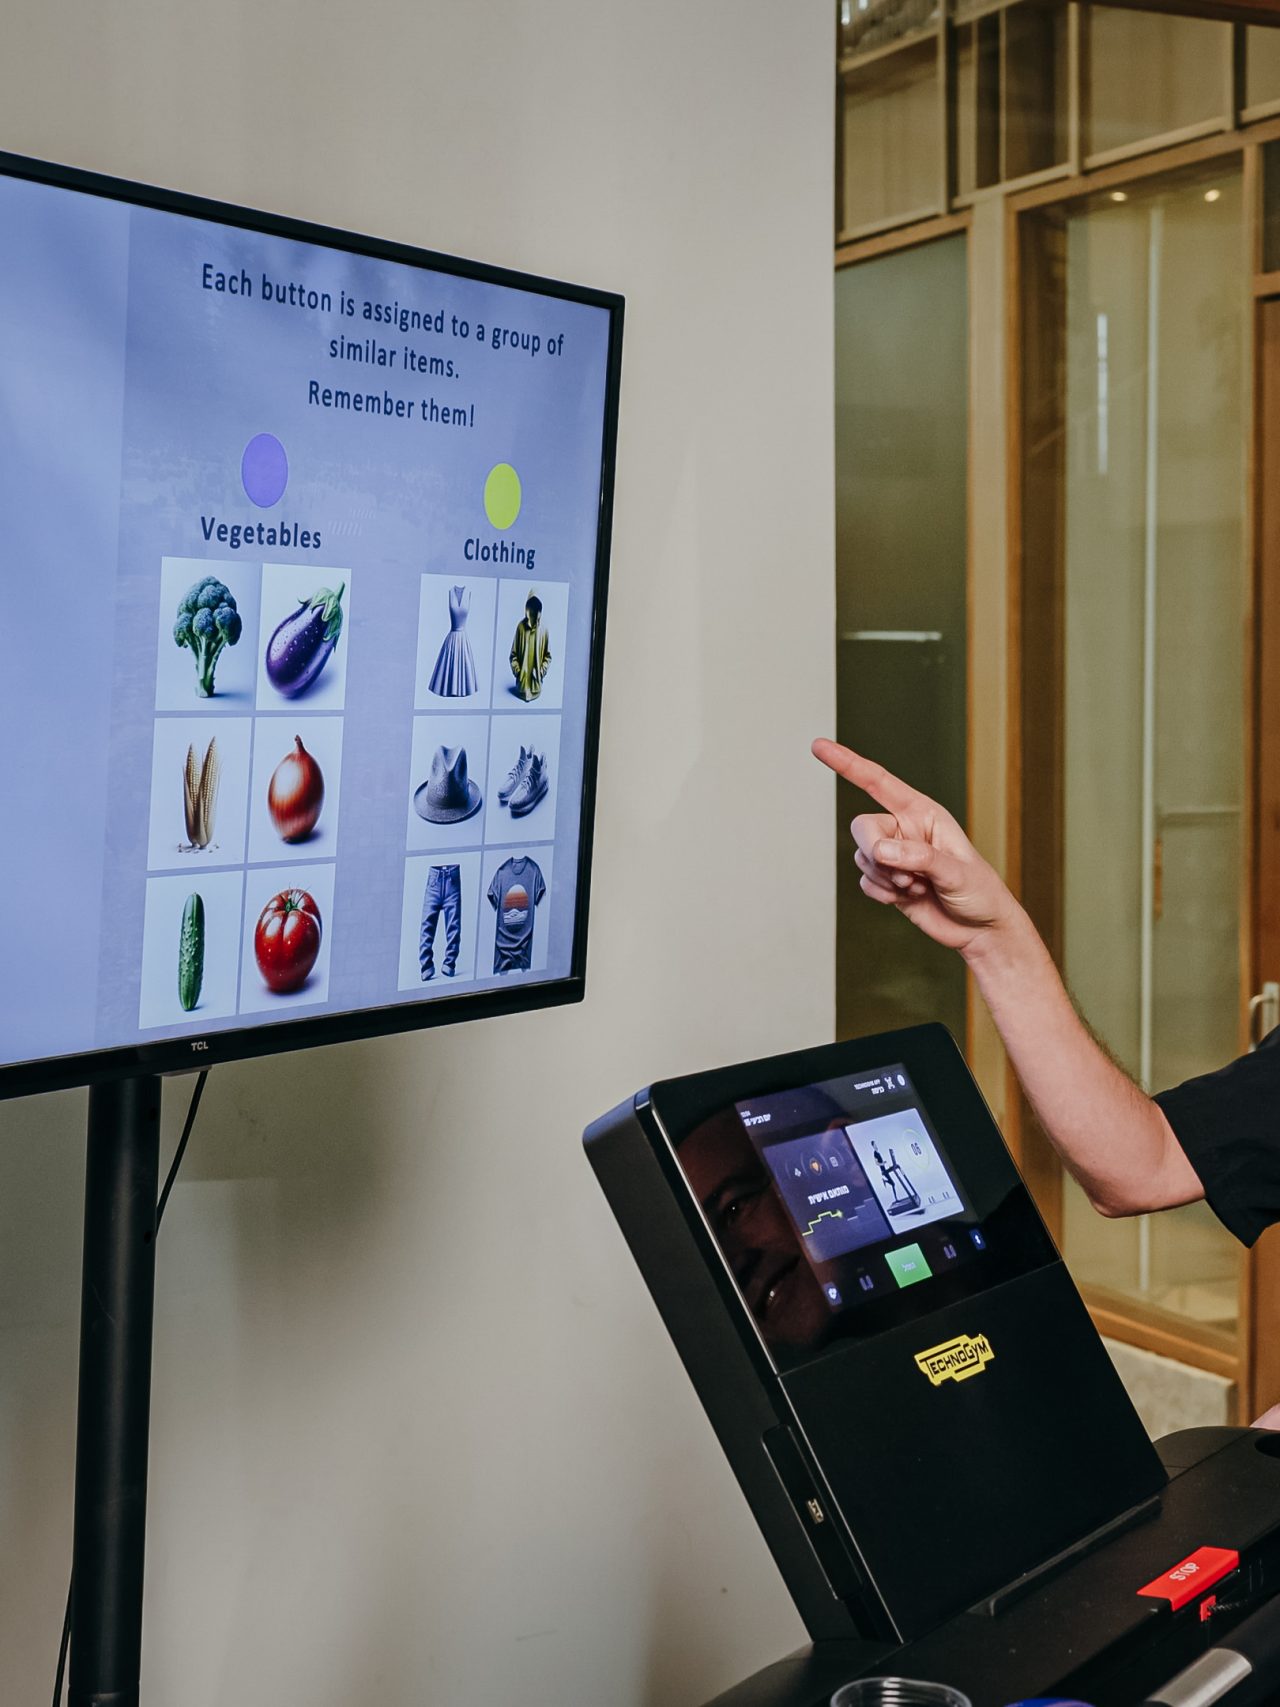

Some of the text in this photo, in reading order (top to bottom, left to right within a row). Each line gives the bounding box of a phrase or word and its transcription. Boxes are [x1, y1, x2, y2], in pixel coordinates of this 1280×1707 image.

[202, 263, 565, 357] Each button is assigned to a group of
[329, 335, 459, 379] similar items.
[308, 379, 475, 428] Remember them!
[201, 516, 322, 550] Vegetables
[464, 538, 536, 570] Clothing
[191, 1041, 209, 1051] TCL
[1169, 1562, 1200, 1581] STOP
